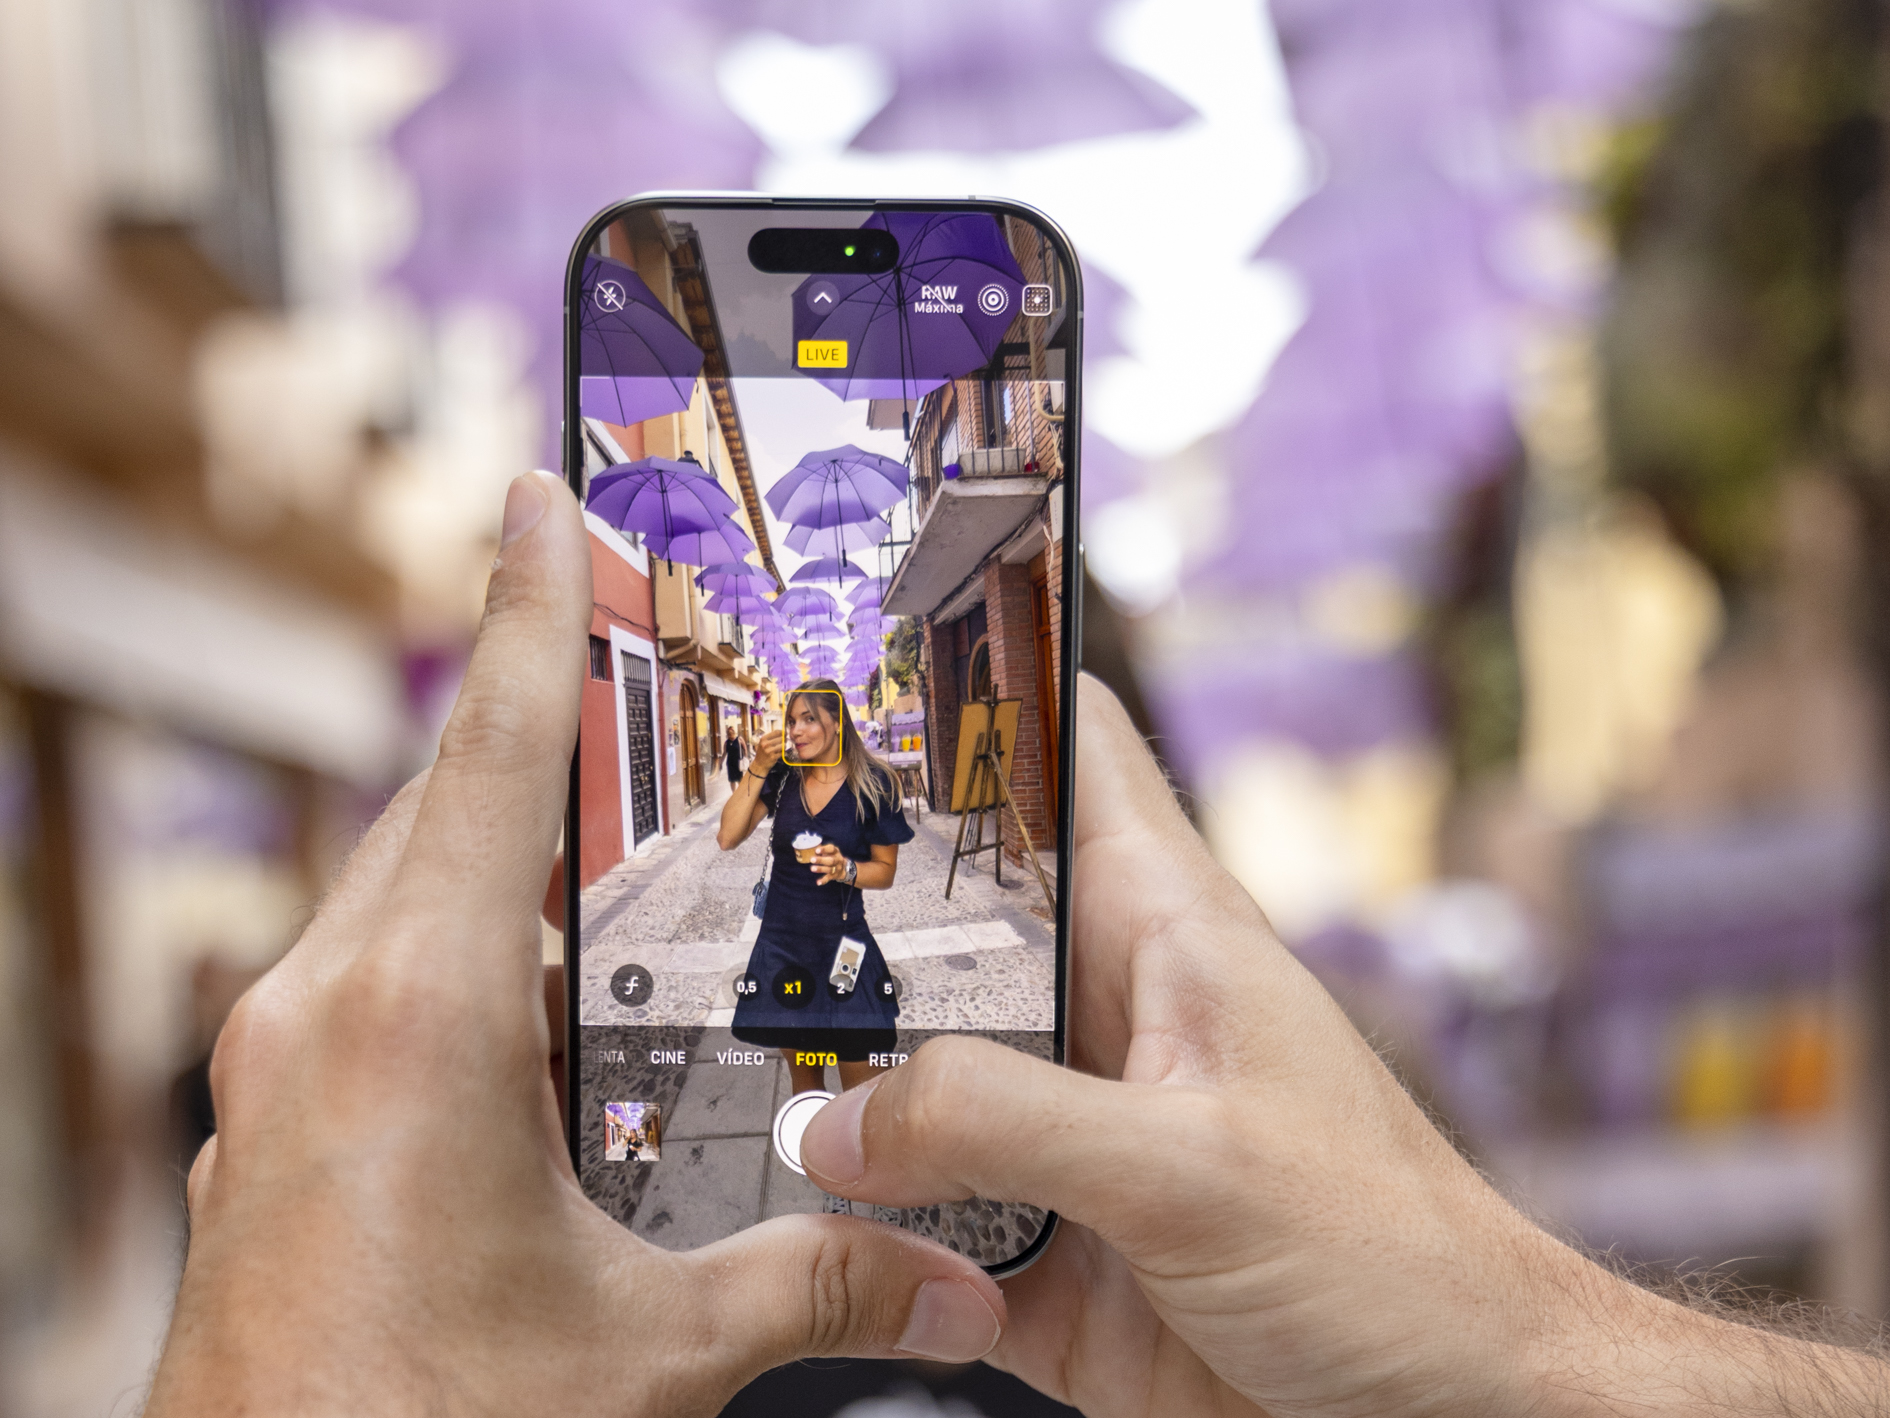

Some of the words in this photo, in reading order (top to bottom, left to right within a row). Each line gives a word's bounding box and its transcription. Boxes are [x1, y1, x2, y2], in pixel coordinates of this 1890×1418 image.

[921, 285, 958, 300] RAW
[914, 300, 964, 314] Máxima
[806, 348, 839, 361] LIVE
[736, 981, 757, 995] 0,5
[784, 981, 802, 995] x1
[836, 982, 846, 995] 2
[883, 983, 893, 995] 5
[651, 1050, 686, 1065] CINE
[716, 1048, 765, 1066] VÍDEO
[795, 1052, 838, 1067] FOTO
